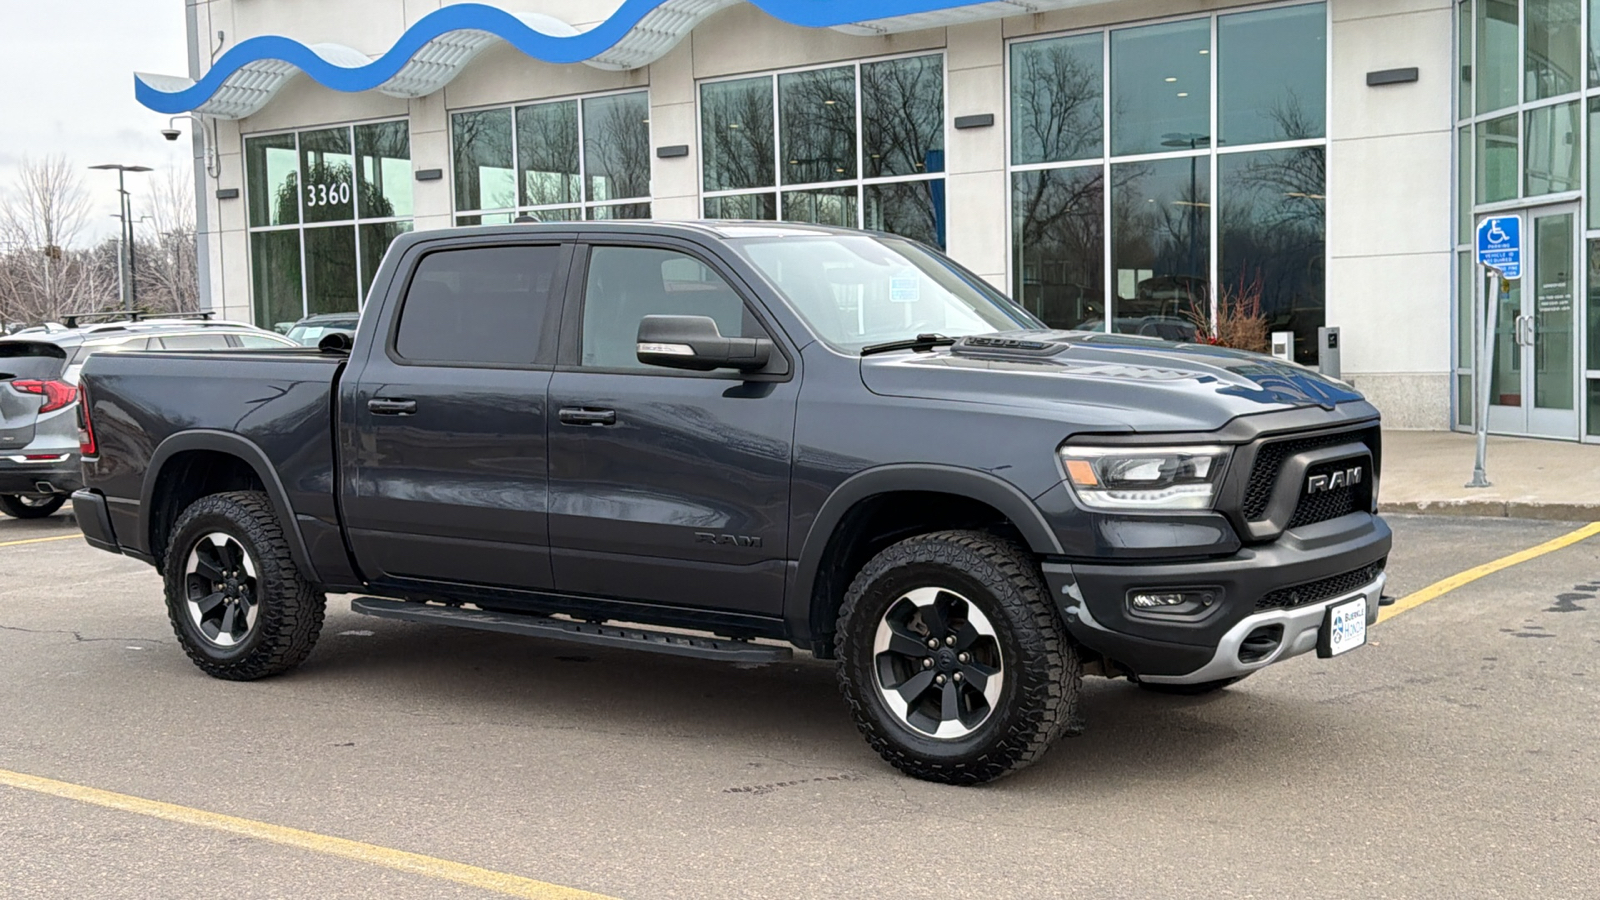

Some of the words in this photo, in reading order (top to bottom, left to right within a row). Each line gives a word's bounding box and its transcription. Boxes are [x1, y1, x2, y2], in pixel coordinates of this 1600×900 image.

[307, 182, 350, 207] 3360
[1308, 466, 1362, 494] RAM
[694, 531, 763, 548] RAM
[1344, 620, 1364, 639] HONDA
